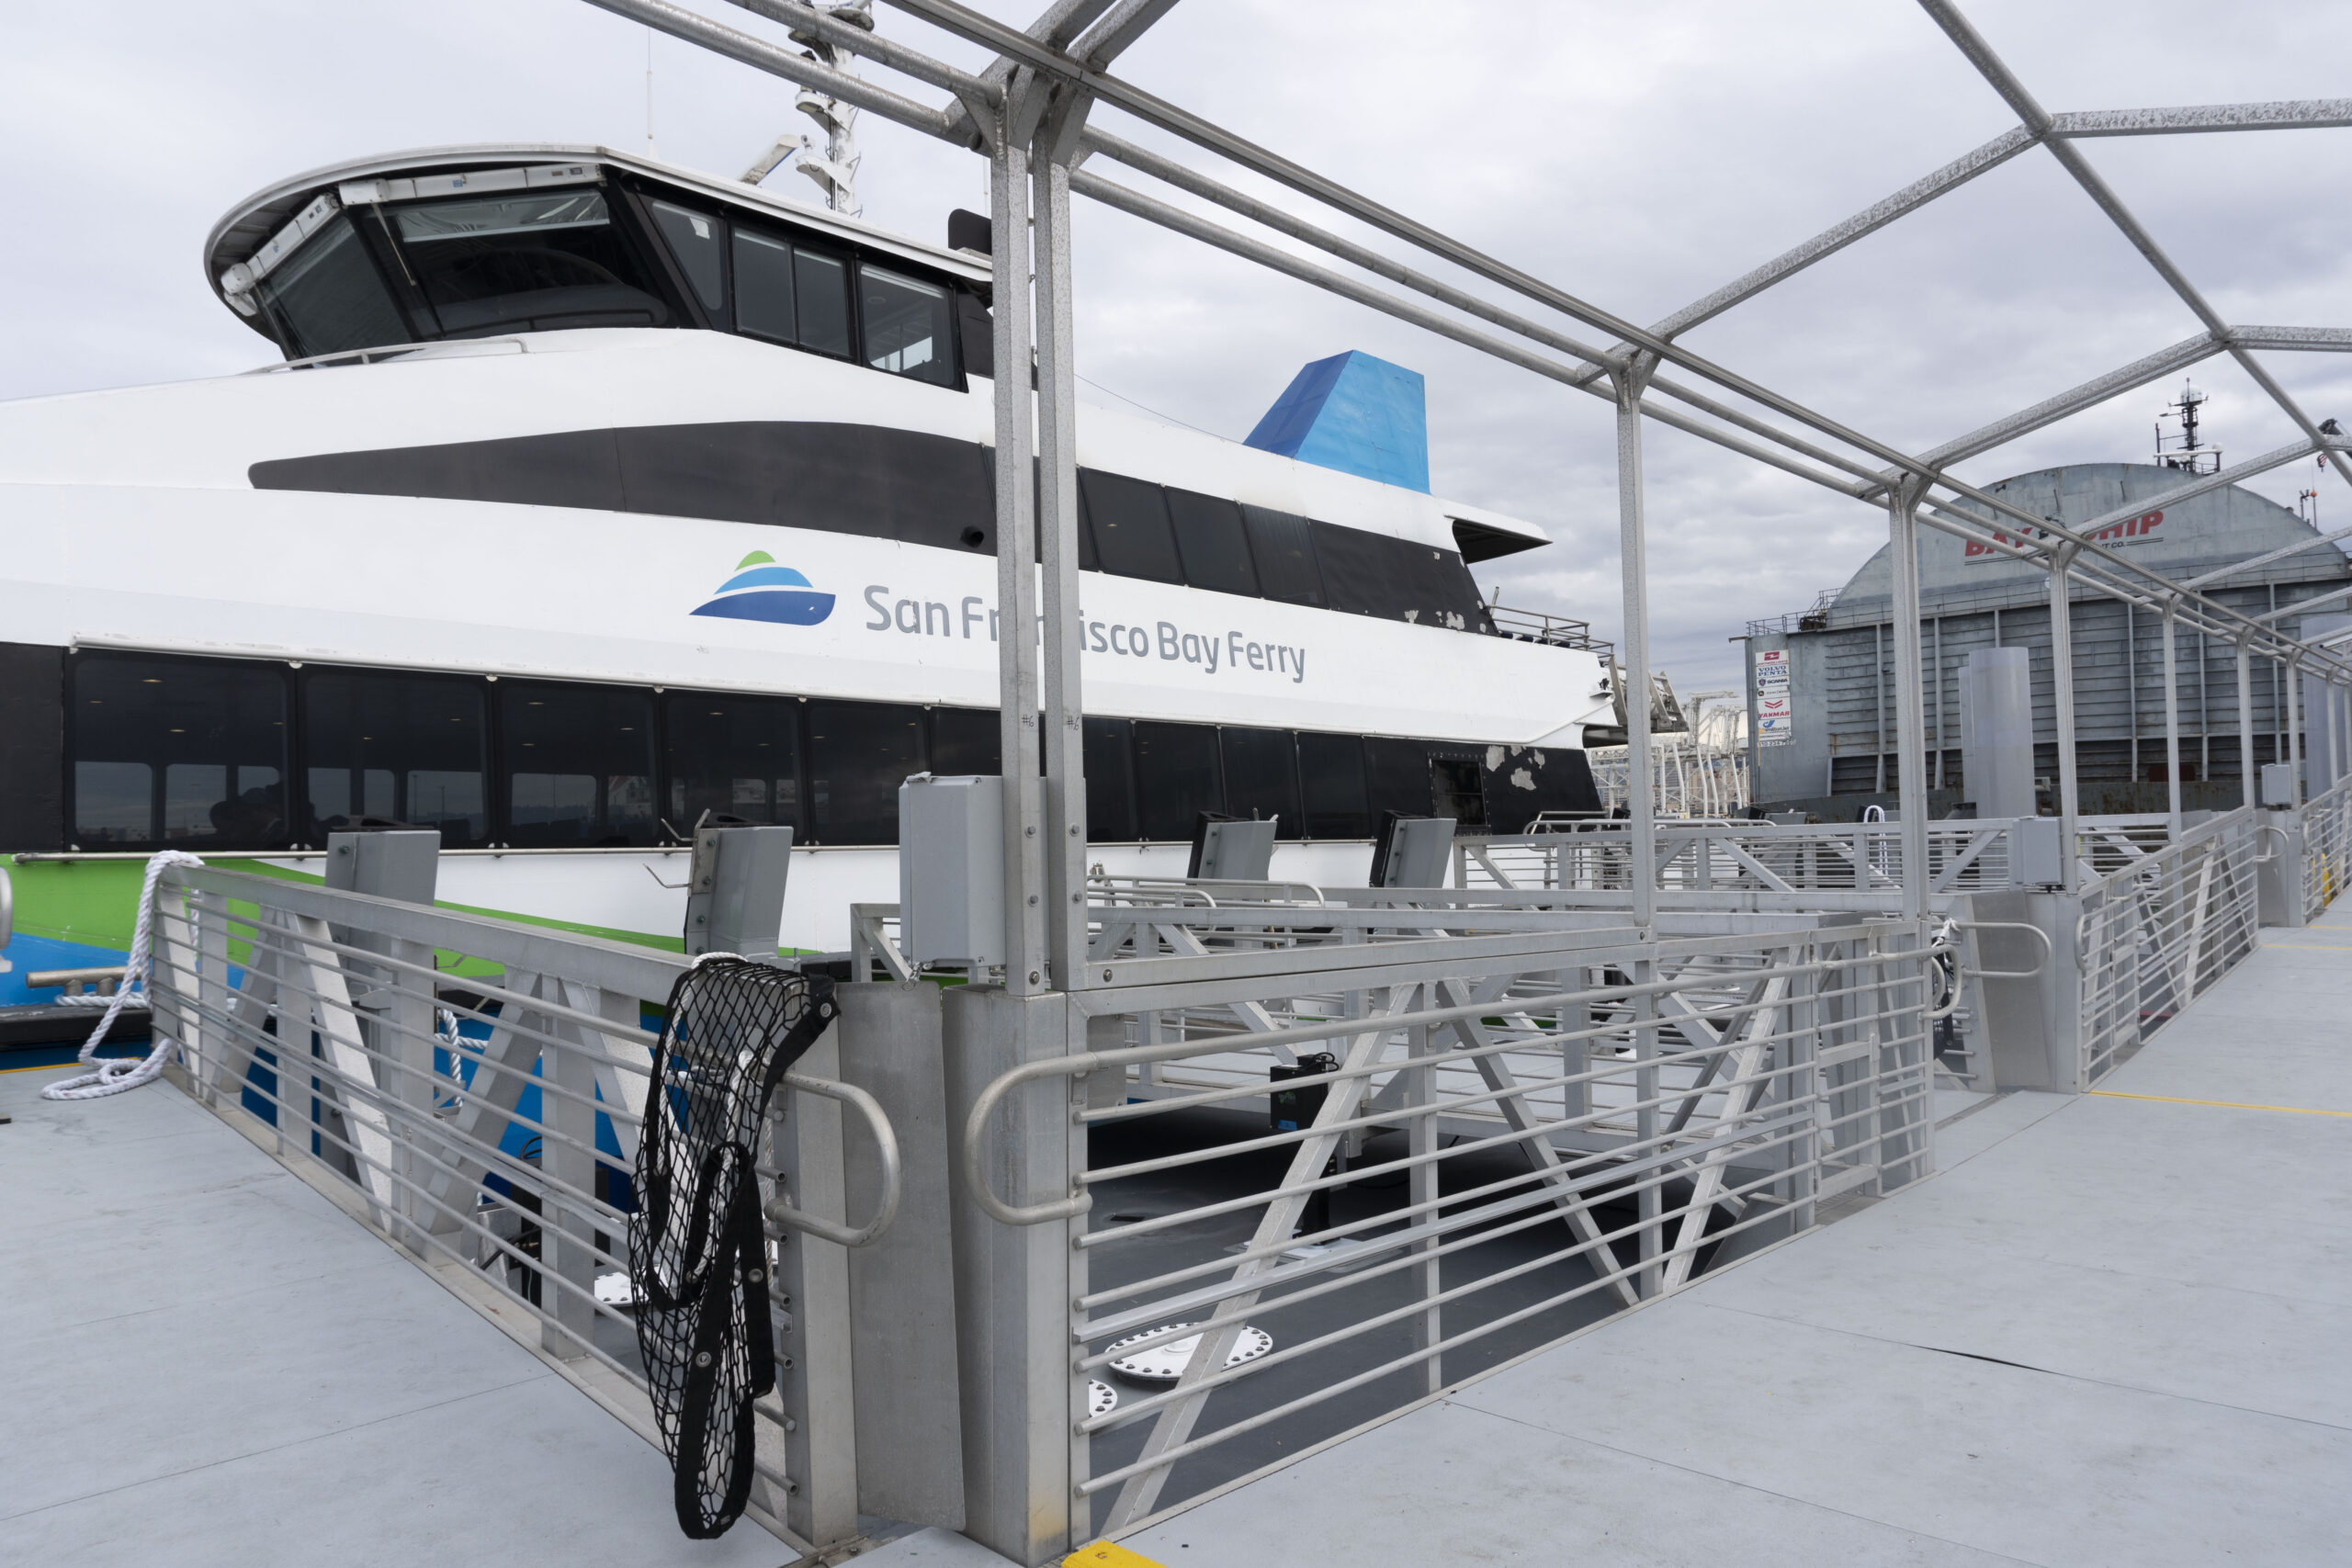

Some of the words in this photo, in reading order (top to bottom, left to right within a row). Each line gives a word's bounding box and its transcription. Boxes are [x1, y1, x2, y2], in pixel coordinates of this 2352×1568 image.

[2079, 510, 2164, 540] HIP
[864, 584, 951, 637] San
[961, 596, 1149, 658] Frisco
[1157, 621, 1220, 674] Bay
[1227, 631, 1305, 683] Ferry
[1021, 714, 1035, 728] #6
[1066, 715, 1080, 730] #6
